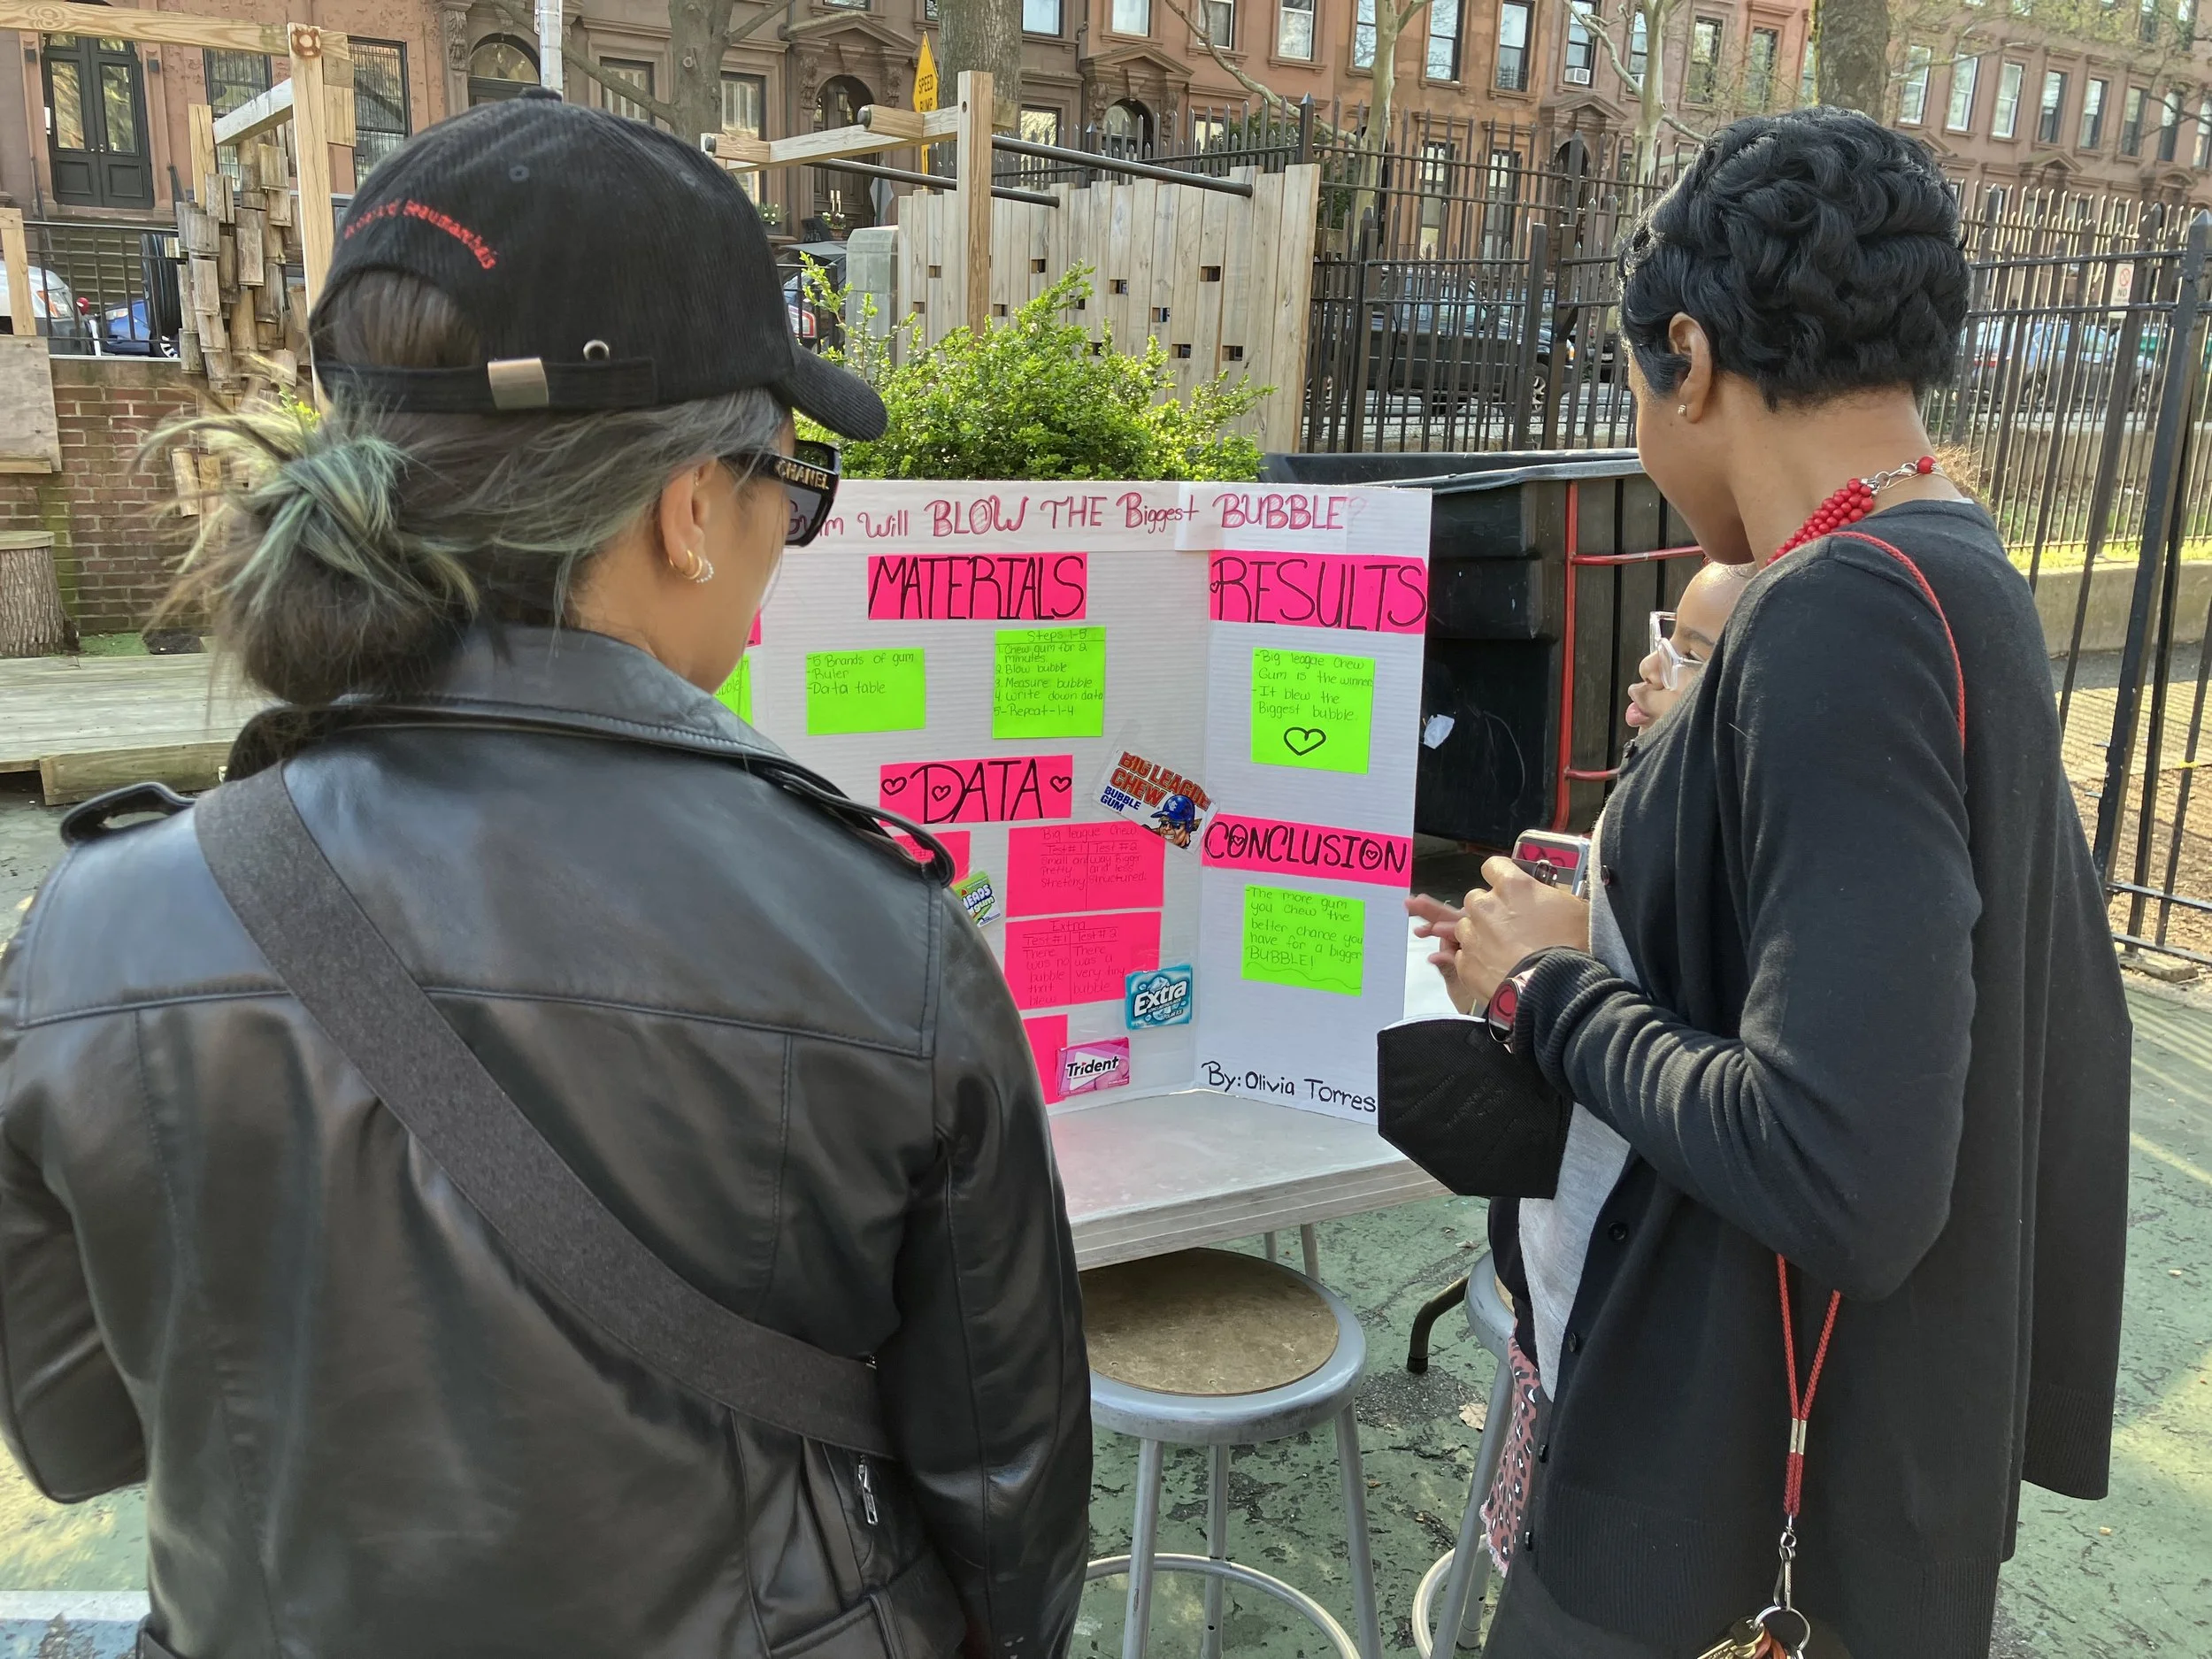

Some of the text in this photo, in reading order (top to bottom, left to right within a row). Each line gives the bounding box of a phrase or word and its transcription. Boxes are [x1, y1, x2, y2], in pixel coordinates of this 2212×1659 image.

[918, 73, 934, 95] SPEED
[857, 509, 909, 539] Will
[923, 494, 1029, 538] BLOW
[1040, 493, 1108, 530] THE
[1116, 491, 1200, 534] Biggest
[867, 555, 1086, 621] MATERIALS
[1211, 557, 1428, 633] RESULTS
[1026, 629, 1064, 643] Steps
[824, 654, 864, 667] Brands
[873, 652, 887, 664] of
[892, 653, 914, 667] gum
[1033, 643, 1056, 656] gum
[1079, 642, 1087, 652] 2
[1005, 664, 1031, 674] Blow
[1037, 662, 1067, 673] bubble
[1258, 666, 1287, 680] Gum
[1296, 672, 1308, 681] is
[1317, 670, 1338, 684] the
[855, 680, 886, 695] table
[1005, 677, 1049, 688] Measure
[1056, 676, 1093, 688] bubble
[1048, 690, 1078, 701] down
[1284, 687, 1311, 701] blew
[1320, 690, 1340, 704] the
[1258, 700, 1300, 719] Biggest
[910, 757, 1044, 826] DATA
[1109, 767, 1168, 809] CHEW
[1118, 750, 1212, 812] BIG LEAGUE
[1100, 795, 1125, 812] GUM
[1103, 785, 1142, 810] BUBBLE
[1041, 827, 1062, 843] Big
[1204, 821, 1408, 874] CONCLUSION
[1250, 902, 1272, 917] you
[1327, 910, 1351, 922] the
[1282, 891, 1312, 903] more
[1321, 897, 1348, 912] gum
[1251, 917, 1287, 933] better
[1343, 933, 1363, 949] you
[1249, 932, 1363, 964] have for a bigger
[1133, 979, 1188, 1018] Extra
[1067, 1056, 1119, 1078] Trident
[1245, 1071, 1295, 1096] Olivia
[1303, 1078, 1377, 1113] Torres
